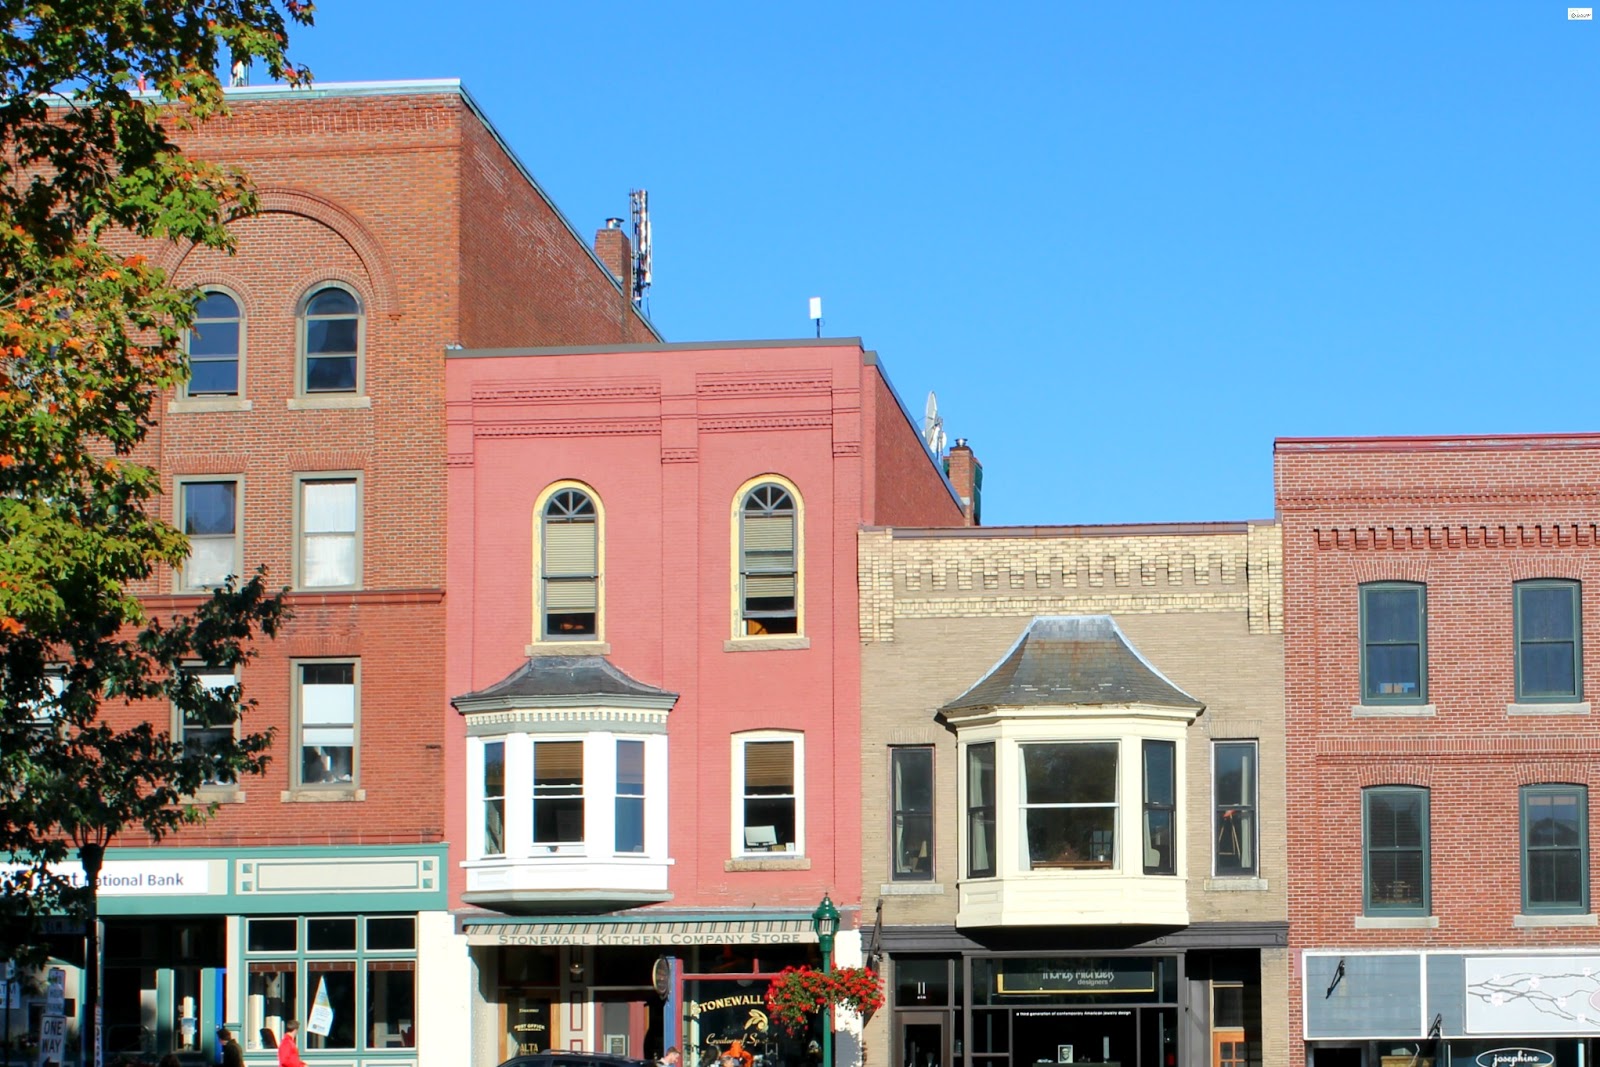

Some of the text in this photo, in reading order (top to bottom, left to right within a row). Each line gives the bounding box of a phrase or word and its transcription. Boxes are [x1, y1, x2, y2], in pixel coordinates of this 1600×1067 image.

[84, 873, 143, 887] ational
[147, 873, 184, 886] Bank
[498, 932, 801, 945] STONEWALL KITCHEN COMPANY STORE
[1077, 979, 1108, 987] designers
[43, 1020, 63, 1036] ONE
[41, 1039, 62, 1054] WAY
[1491, 1050, 1540, 1067] josephine
